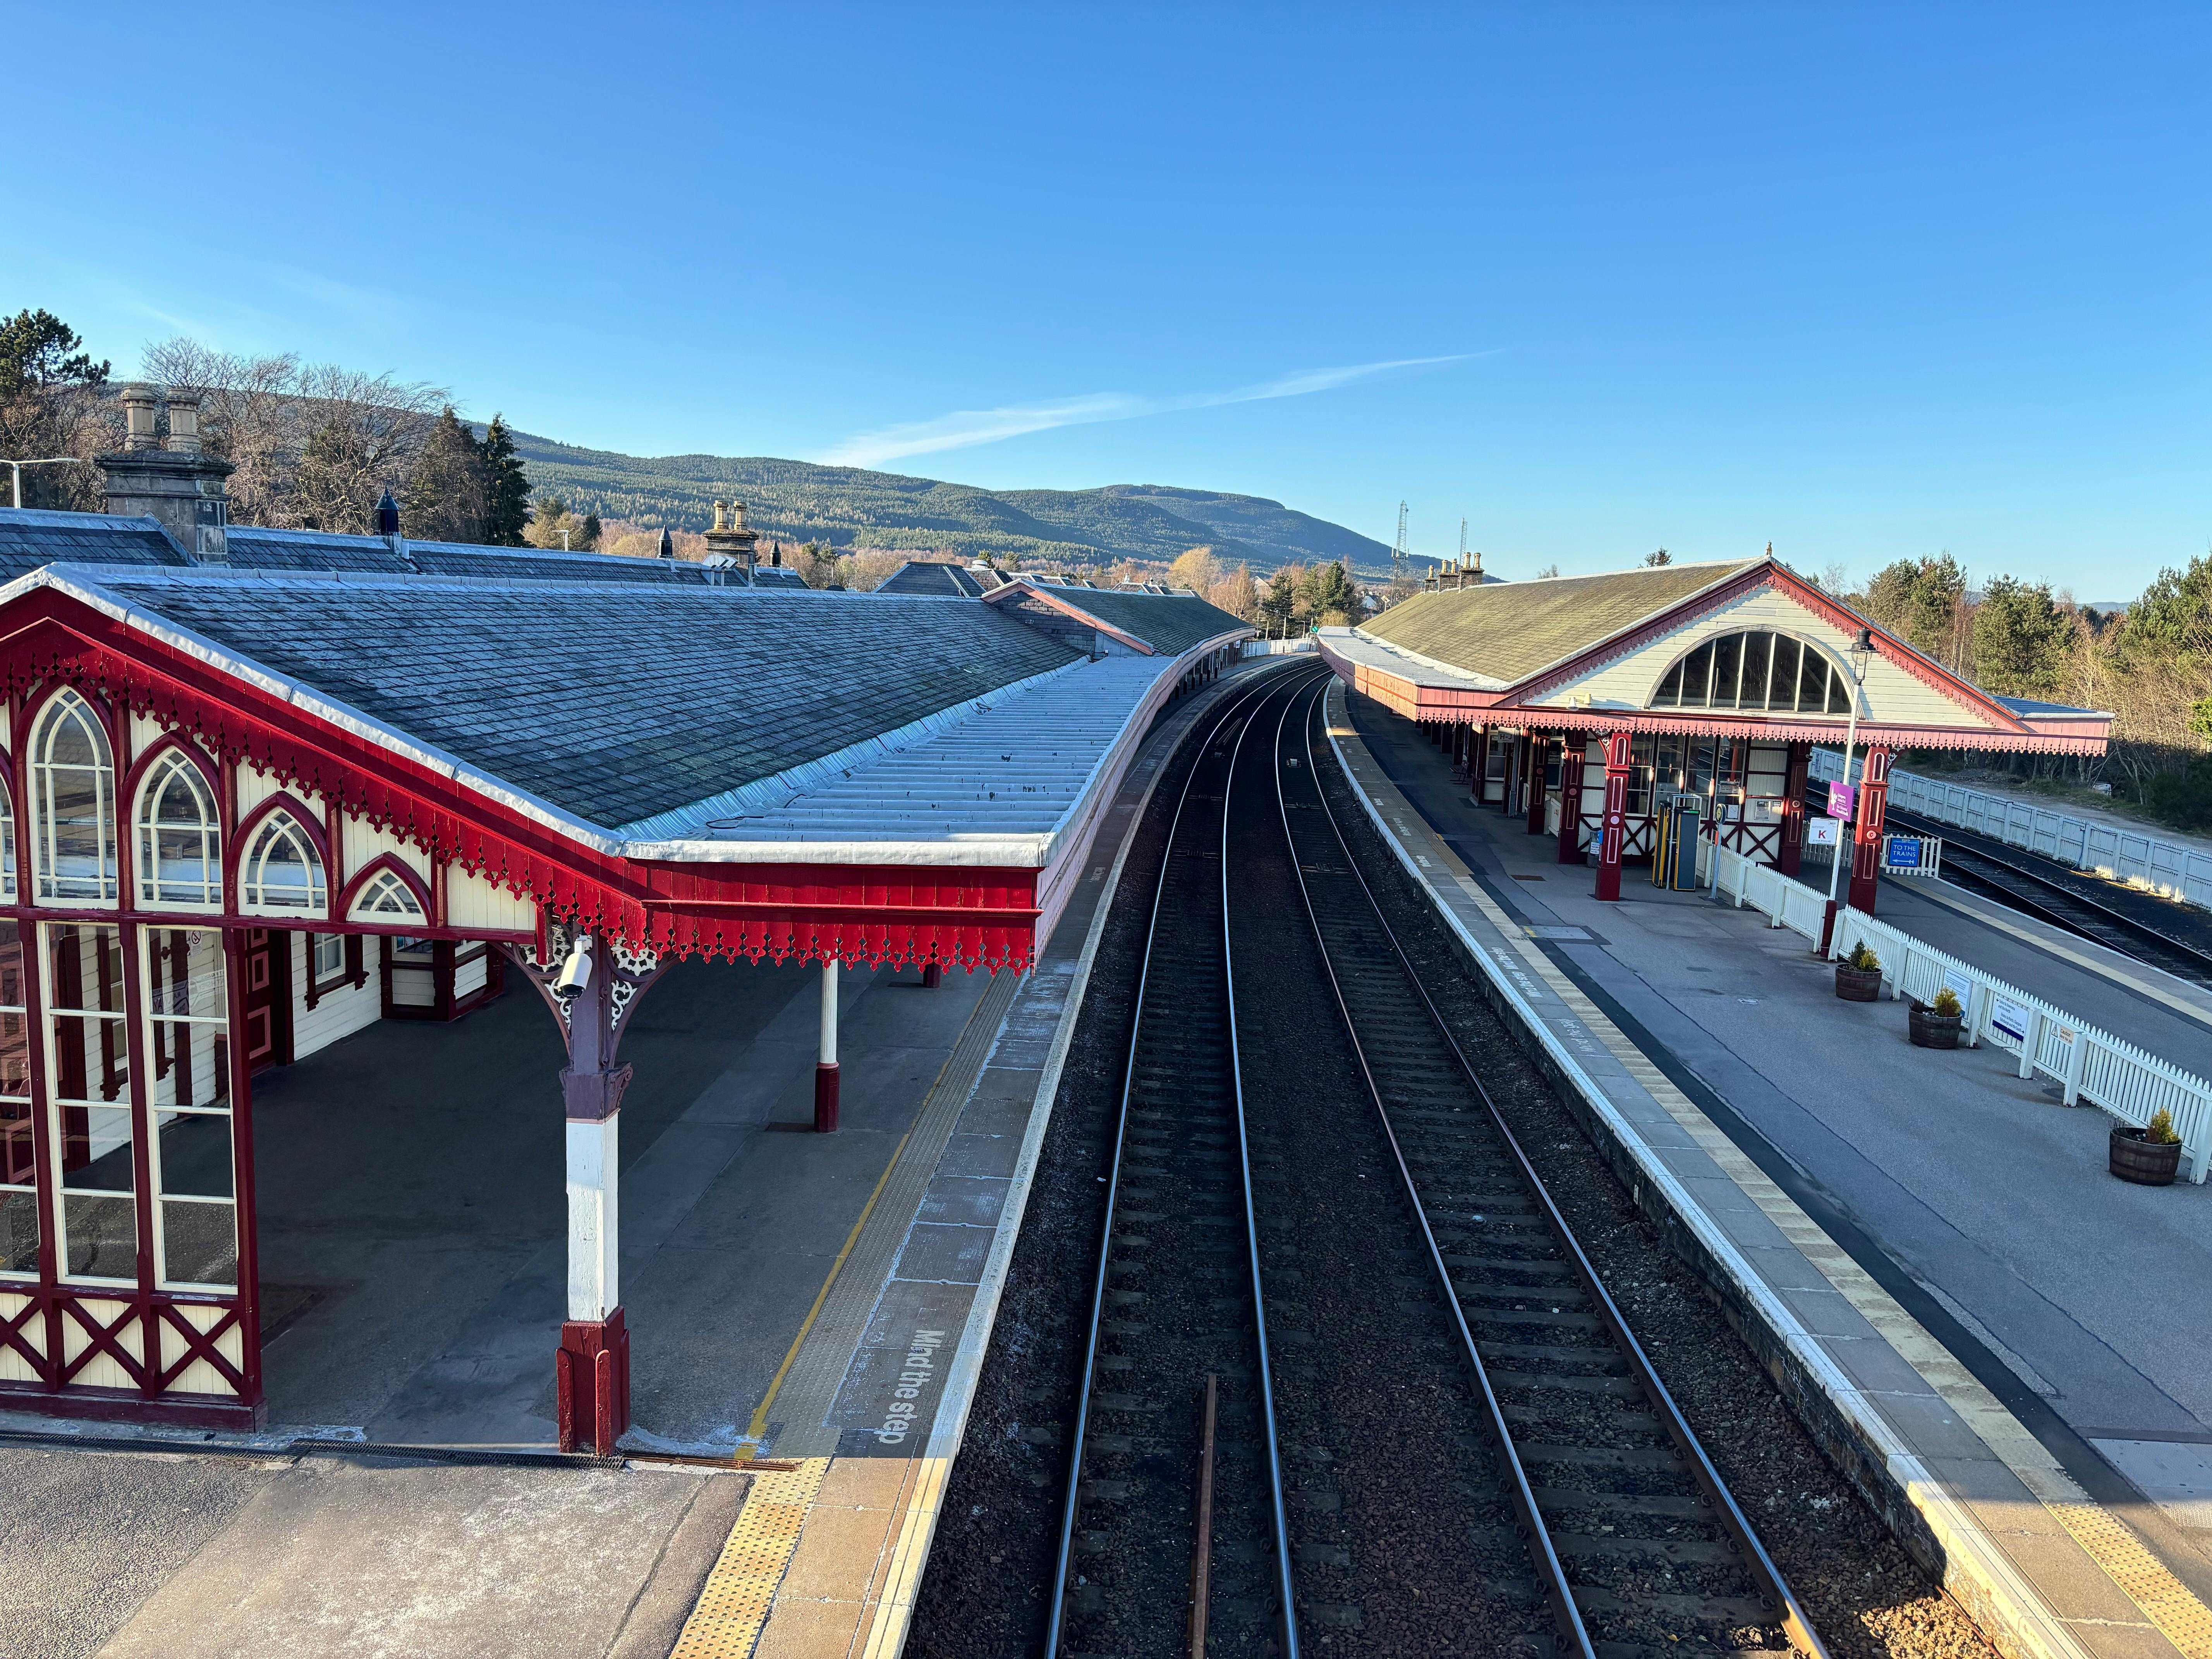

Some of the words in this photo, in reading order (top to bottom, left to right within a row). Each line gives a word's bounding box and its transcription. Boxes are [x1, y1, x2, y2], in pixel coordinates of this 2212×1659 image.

[1818, 830, 1828, 839] K
[1521, 987, 1543, 998] Mind
[1567, 1029, 1585, 1037] the
[1571, 1038, 1597, 1052] Mind
[905, 1330, 945, 1368] Mind
[895, 1371, 931, 1399] the
[874, 1402, 918, 1444] step
